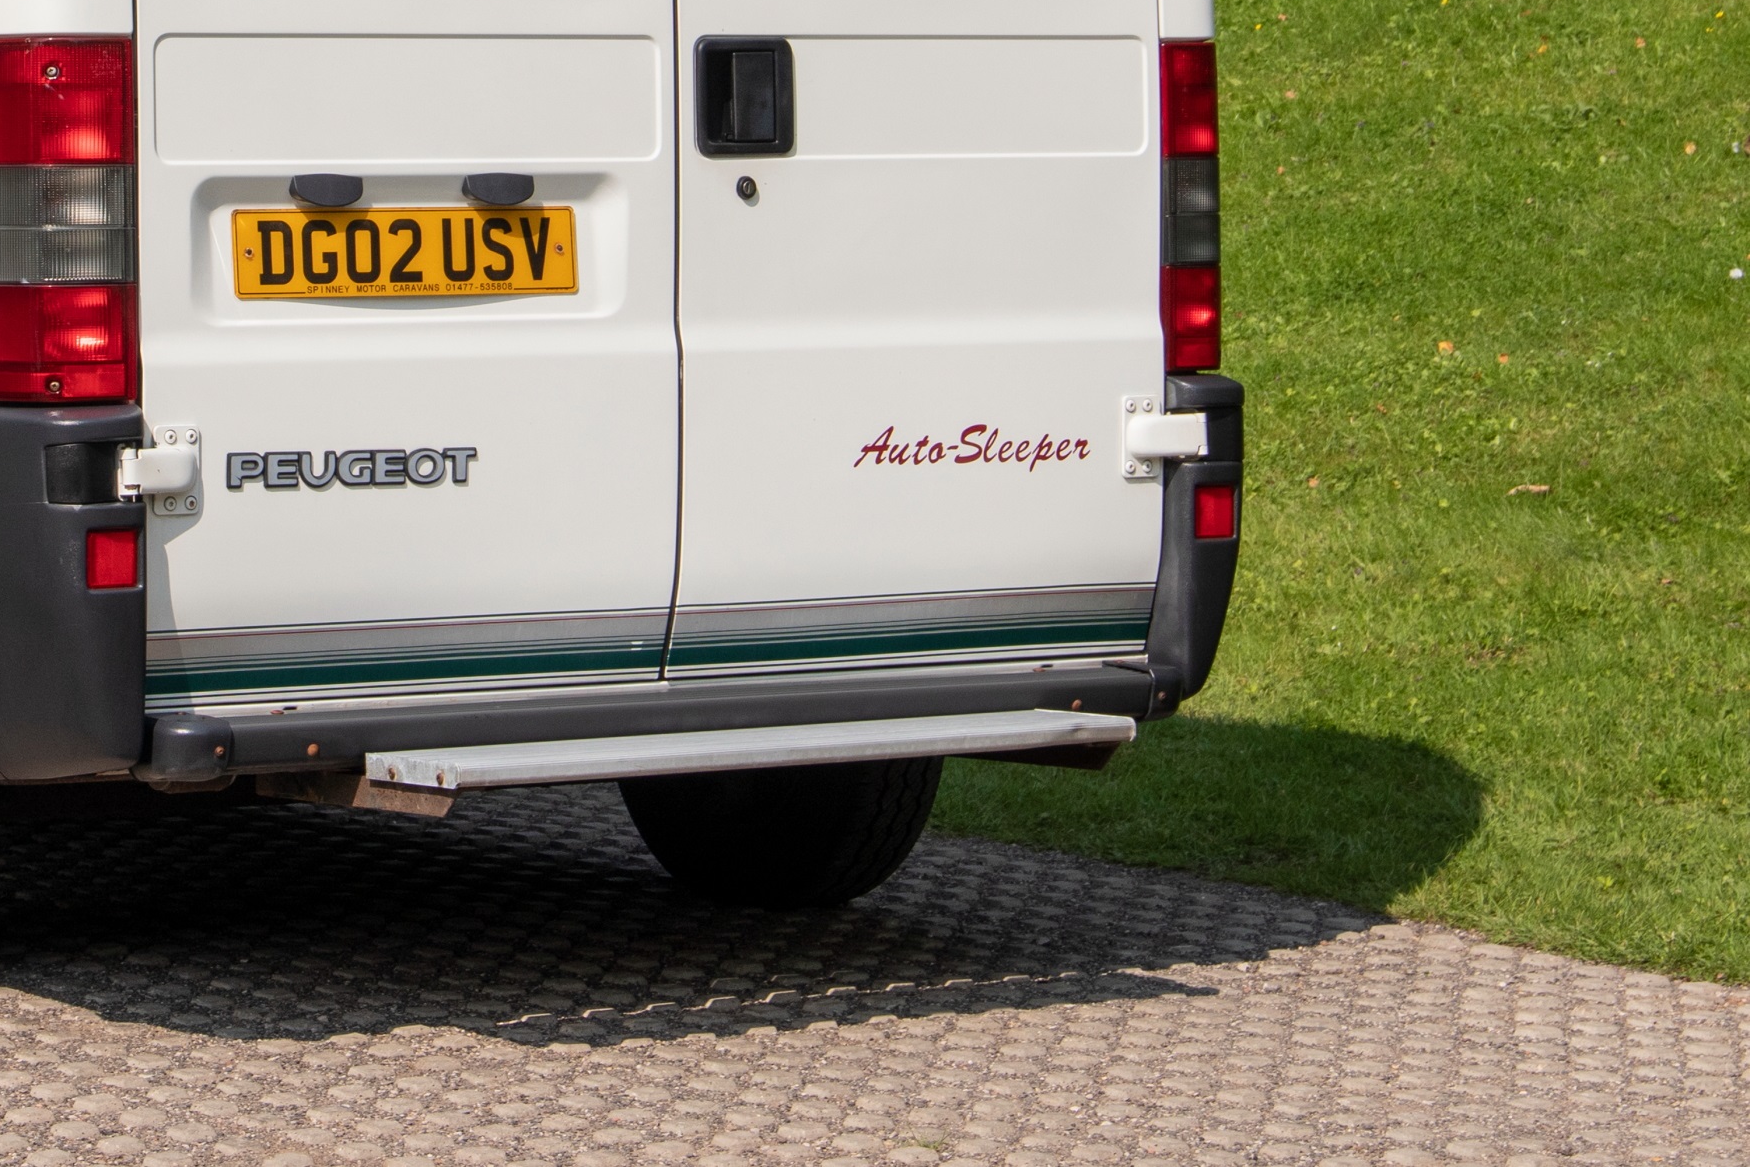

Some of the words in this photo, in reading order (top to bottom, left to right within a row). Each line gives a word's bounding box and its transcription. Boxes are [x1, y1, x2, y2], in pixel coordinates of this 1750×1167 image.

[257, 218, 423, 286] DG02
[442, 217, 550, 281] USV
[306, 286, 350, 294] SPINNEY
[356, 284, 387, 293] MOTOR
[392, 284, 440, 293] CARAVANS
[445, 282, 513, 292] 01477-535808
[226, 447, 477, 489] PEUGEOT
[853, 423, 1091, 473] Auto-Sleeper
